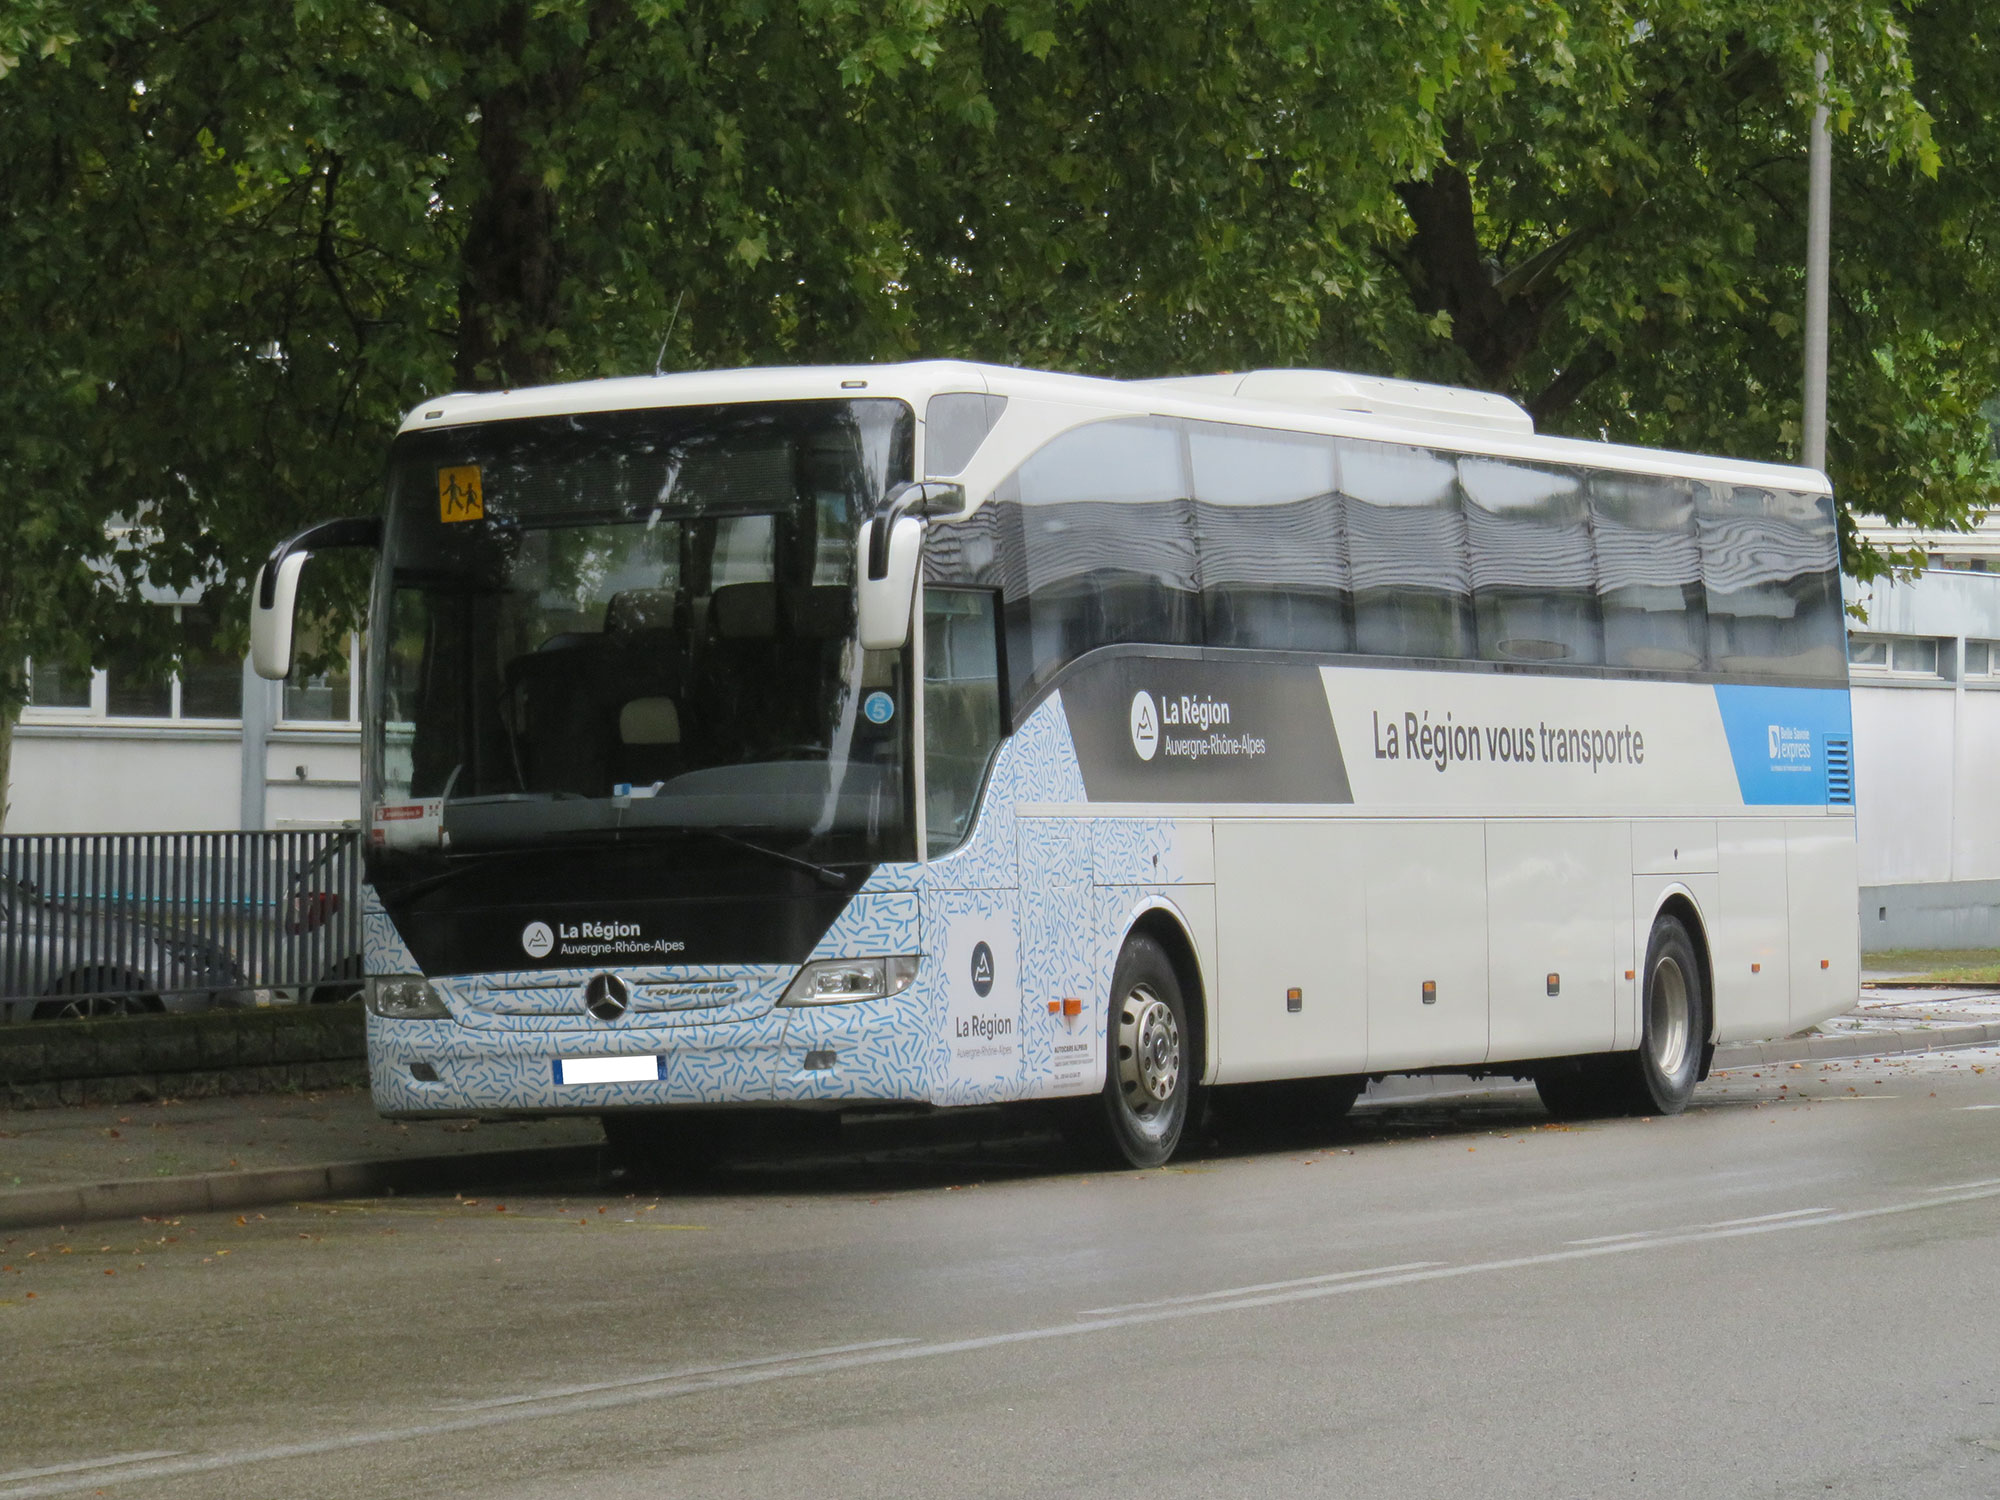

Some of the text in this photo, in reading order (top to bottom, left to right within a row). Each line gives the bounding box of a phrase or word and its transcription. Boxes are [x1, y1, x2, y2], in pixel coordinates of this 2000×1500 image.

[872, 703, 886, 719] 5
[1163, 695, 1229, 731] La Région
[1165, 734, 1265, 759] Auvergne-Rhône-Alpes
[1373, 710, 1644, 772] La Région vous transporte
[1781, 743, 1810, 762] express
[560, 921, 641, 940] La Région
[561, 940, 685, 955] Auvergne-Rhône-Alpes
[647, 986, 739, 996] TOURISMO
[956, 1014, 1011, 1040] La Région
[957, 1045, 1012, 1060] Auvergne-Rhône-Alpes
